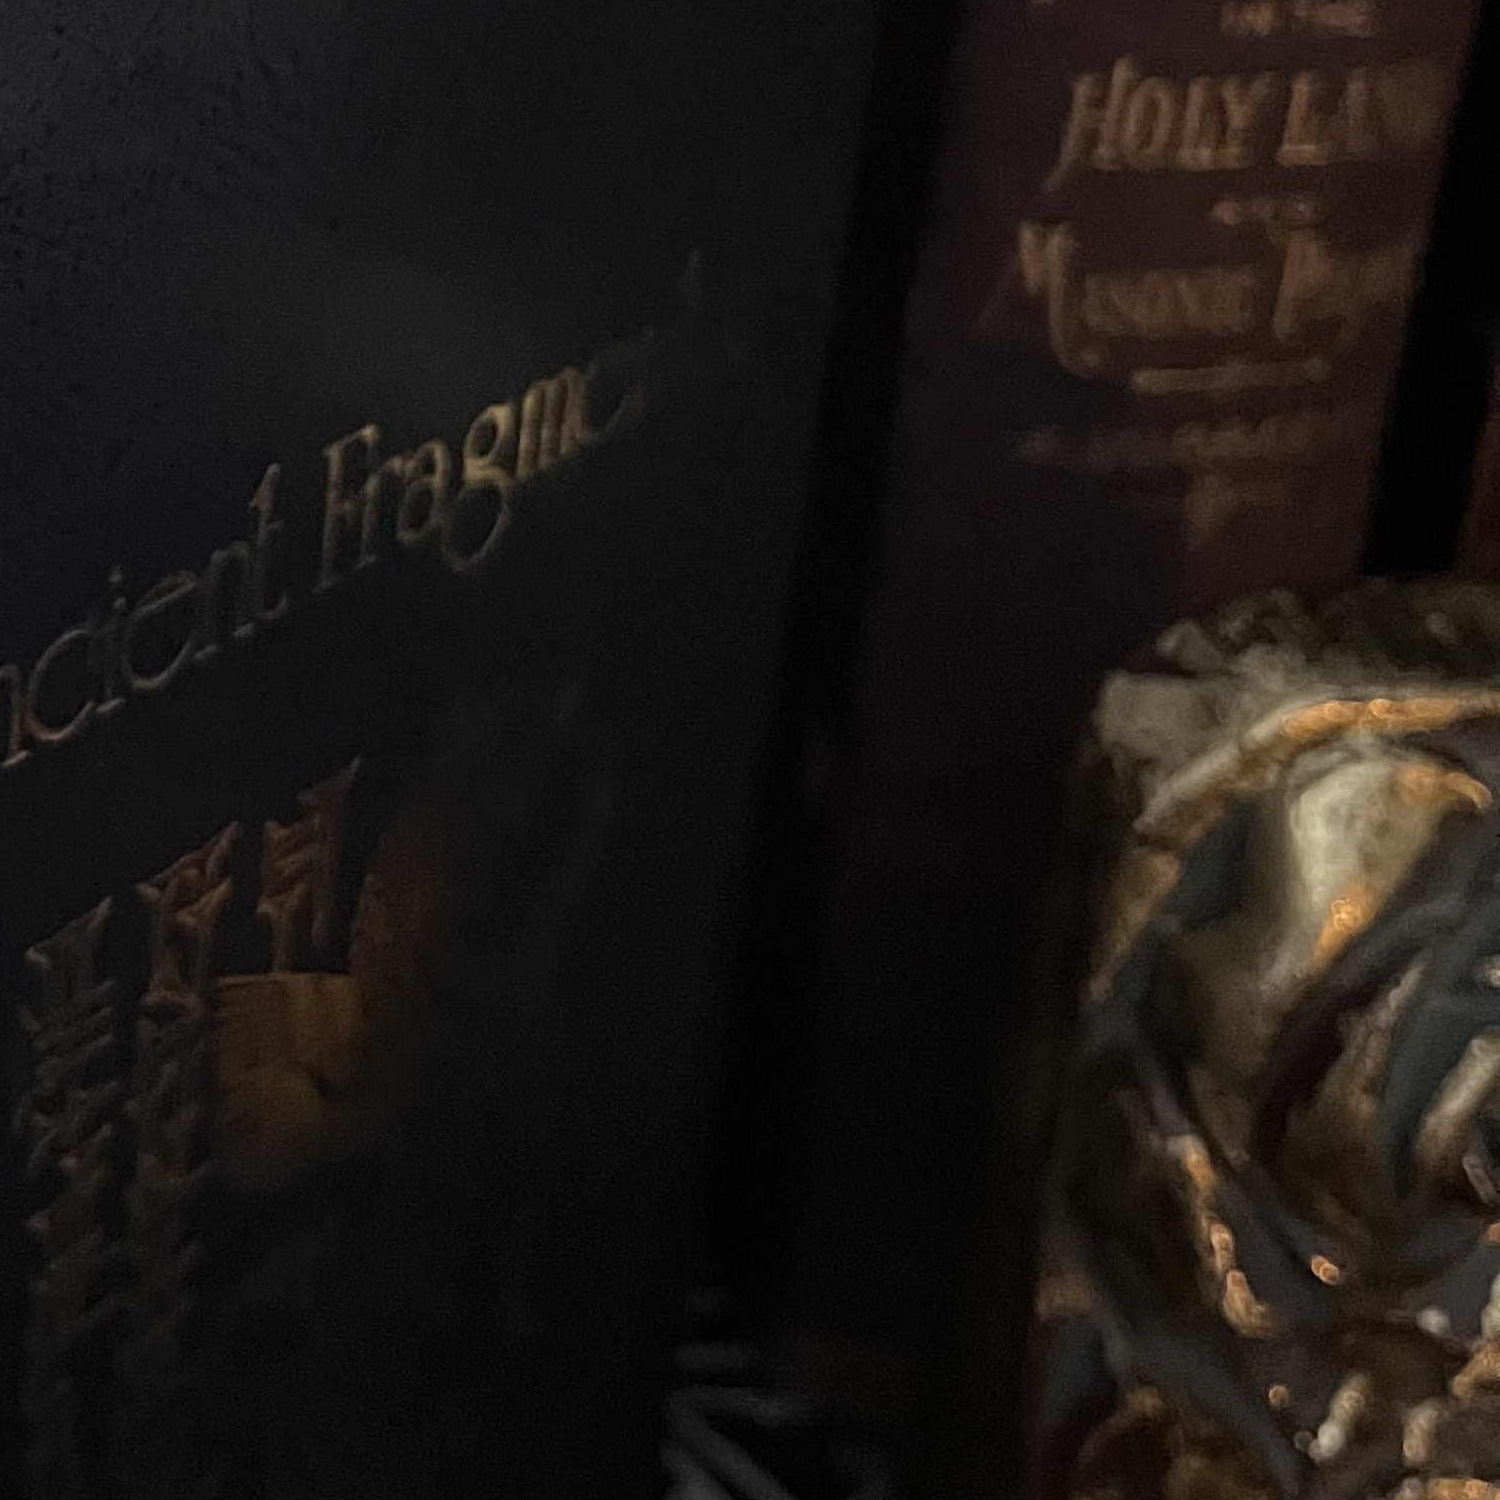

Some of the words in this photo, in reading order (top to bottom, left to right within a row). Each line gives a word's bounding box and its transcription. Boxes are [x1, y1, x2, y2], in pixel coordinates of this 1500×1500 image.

[1042, 55, 1279, 193] HOLY
[1276, 58, 1455, 167] LA
[312, 245, 707, 577] Fragme
